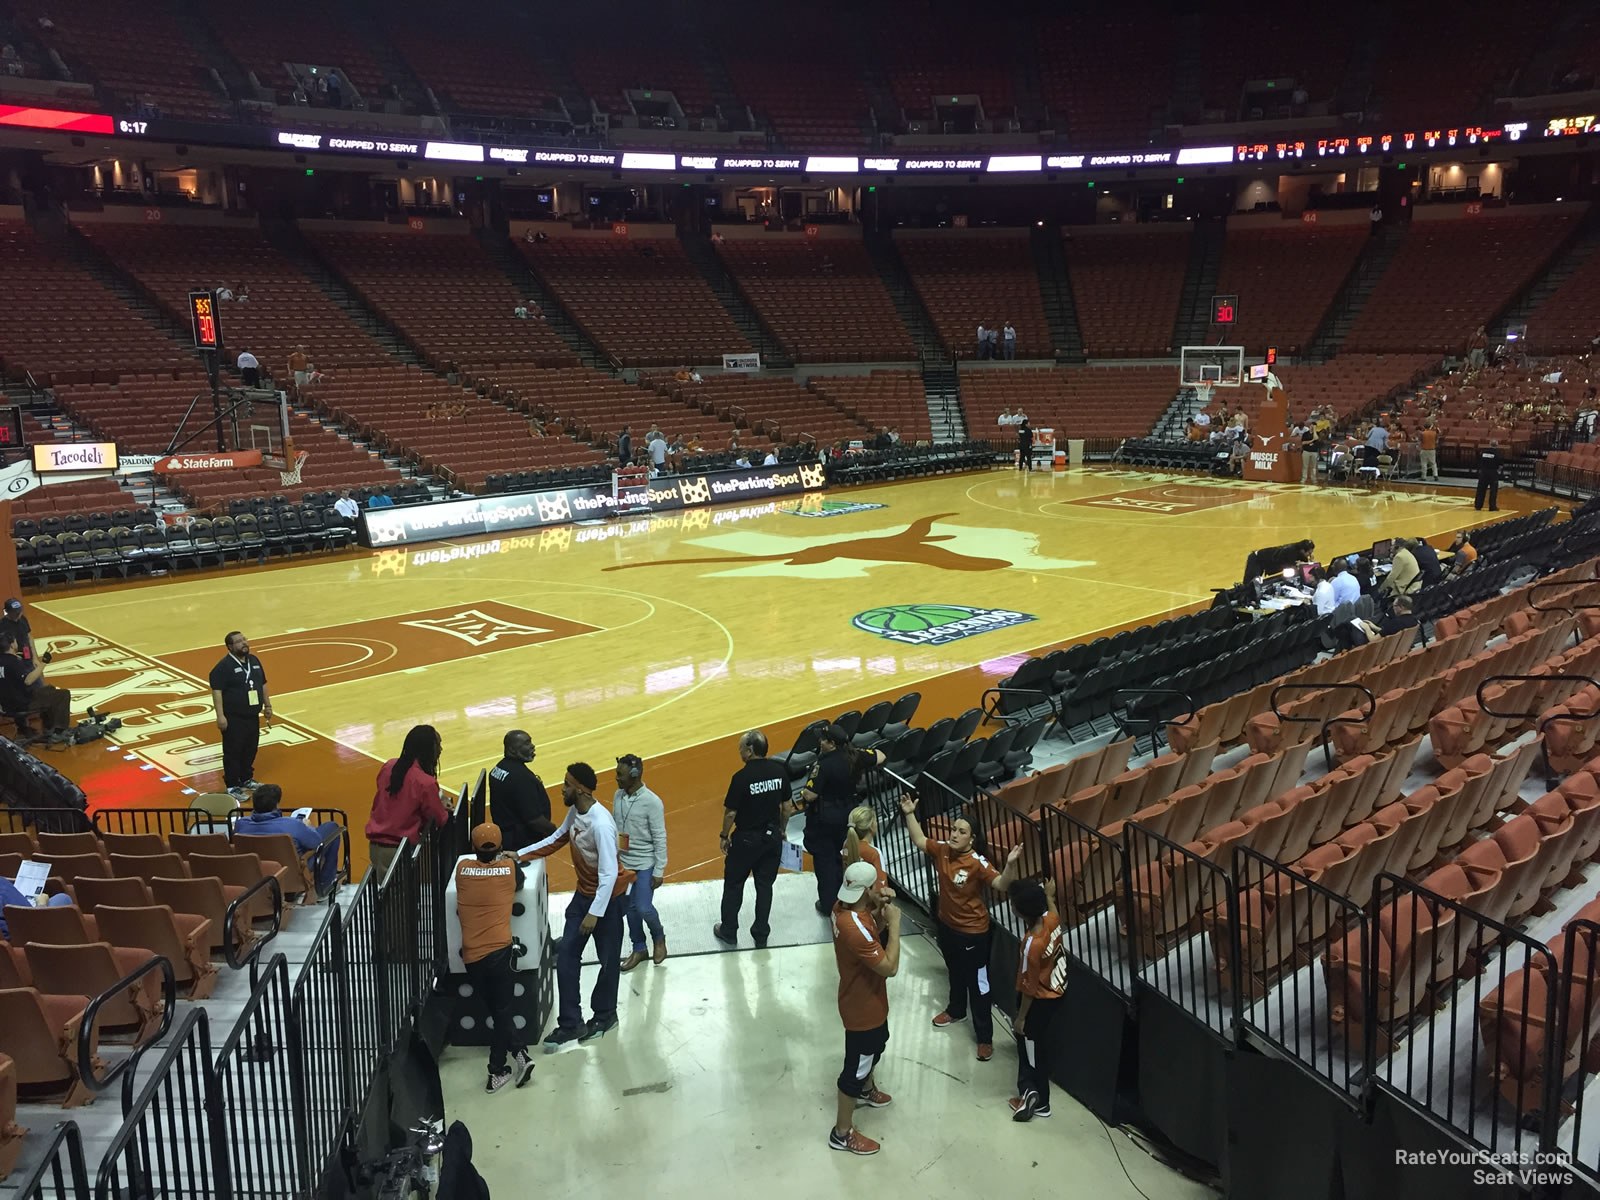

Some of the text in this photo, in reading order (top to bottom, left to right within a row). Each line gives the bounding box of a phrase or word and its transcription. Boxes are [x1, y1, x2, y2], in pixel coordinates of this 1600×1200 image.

[120, 120, 147, 134] 6:17
[329, 138, 374, 150] EQUIPPED
[376, 142, 388, 151] TO
[389, 143, 418, 153] SERVE
[535, 152, 576, 162] EQUIPPED
[577, 154, 588, 163] TO
[590, 155, 615, 164] SERVE
[724, 159, 762, 168] EQUIPPED
[1090, 156, 1131, 165] EQUIPPED
[1132, 155, 1143, 163] TO
[1144, 153, 1171, 162] SERVE
[956, 160, 981, 168] SERVE
[146, 210, 160, 220] 20
[1467, 206, 1480, 214] 43
[411, 221, 423, 230] 49
[615, 226, 626, 234] 48
[1217, 306, 1232, 321] 30
[200, 316, 215, 343] 30
[1250, 452, 1278, 462] MUSCLE
[1255, 461, 1272, 470] MILK
[890, 610, 1023, 644] LEGENDS
[931, 618, 1032, 644] CLASSIC
[750, 778, 782, 795] SECURITY
[460, 867, 511, 876] LONGHORNS
